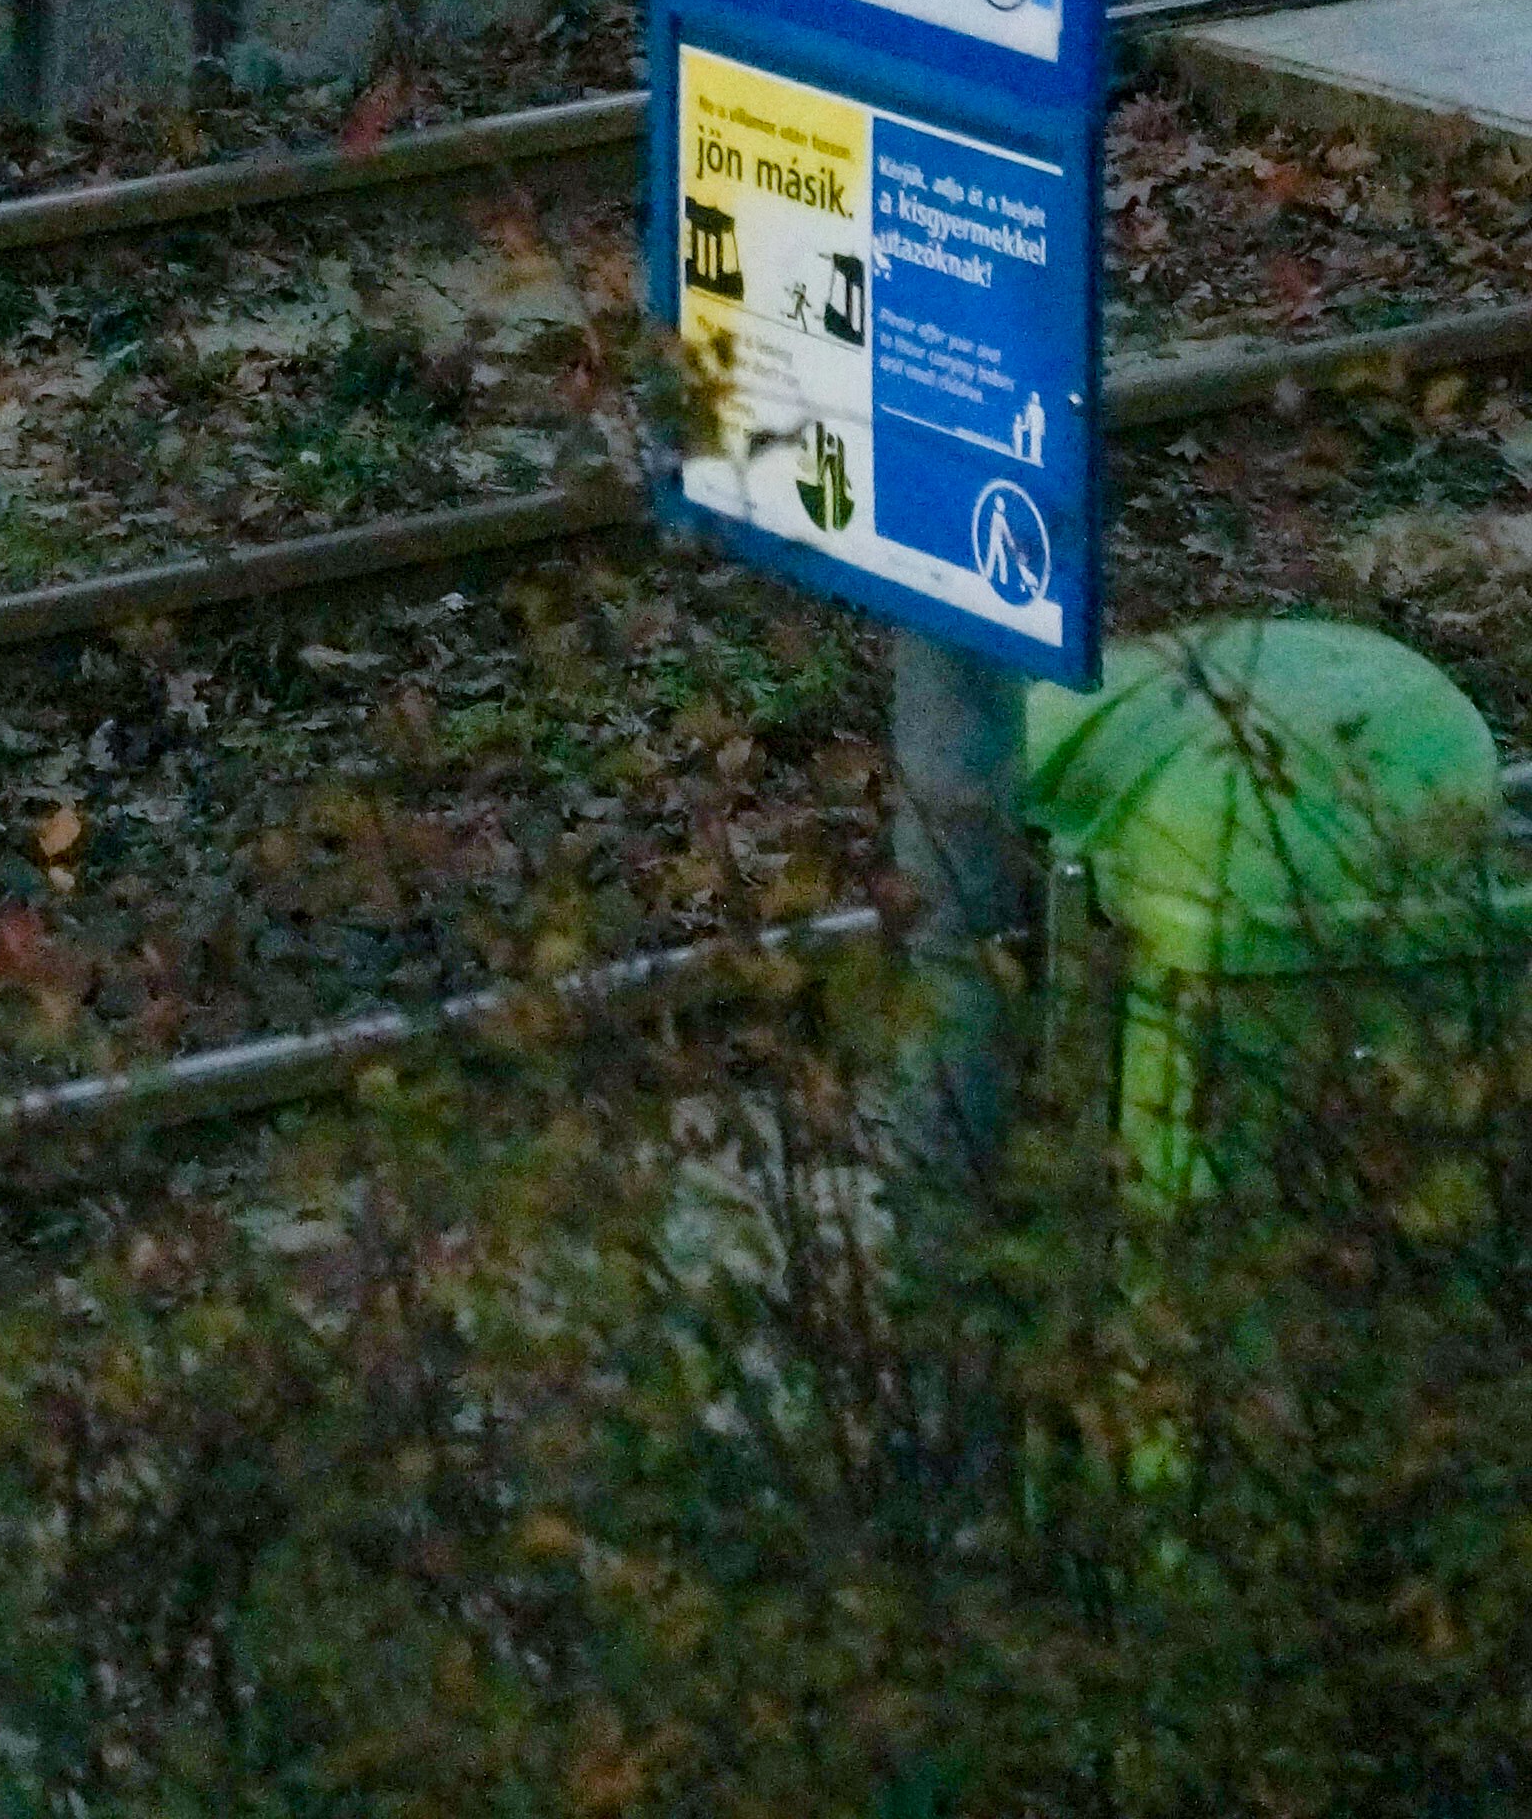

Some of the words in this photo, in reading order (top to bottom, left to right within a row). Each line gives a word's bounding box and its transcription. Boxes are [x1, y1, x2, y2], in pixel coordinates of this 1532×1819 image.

[697, 125, 742, 181] jön
[757, 156, 853, 220] másik.
[878, 190, 892, 214] a
[899, 190, 1046, 266] kisgyermekkel
